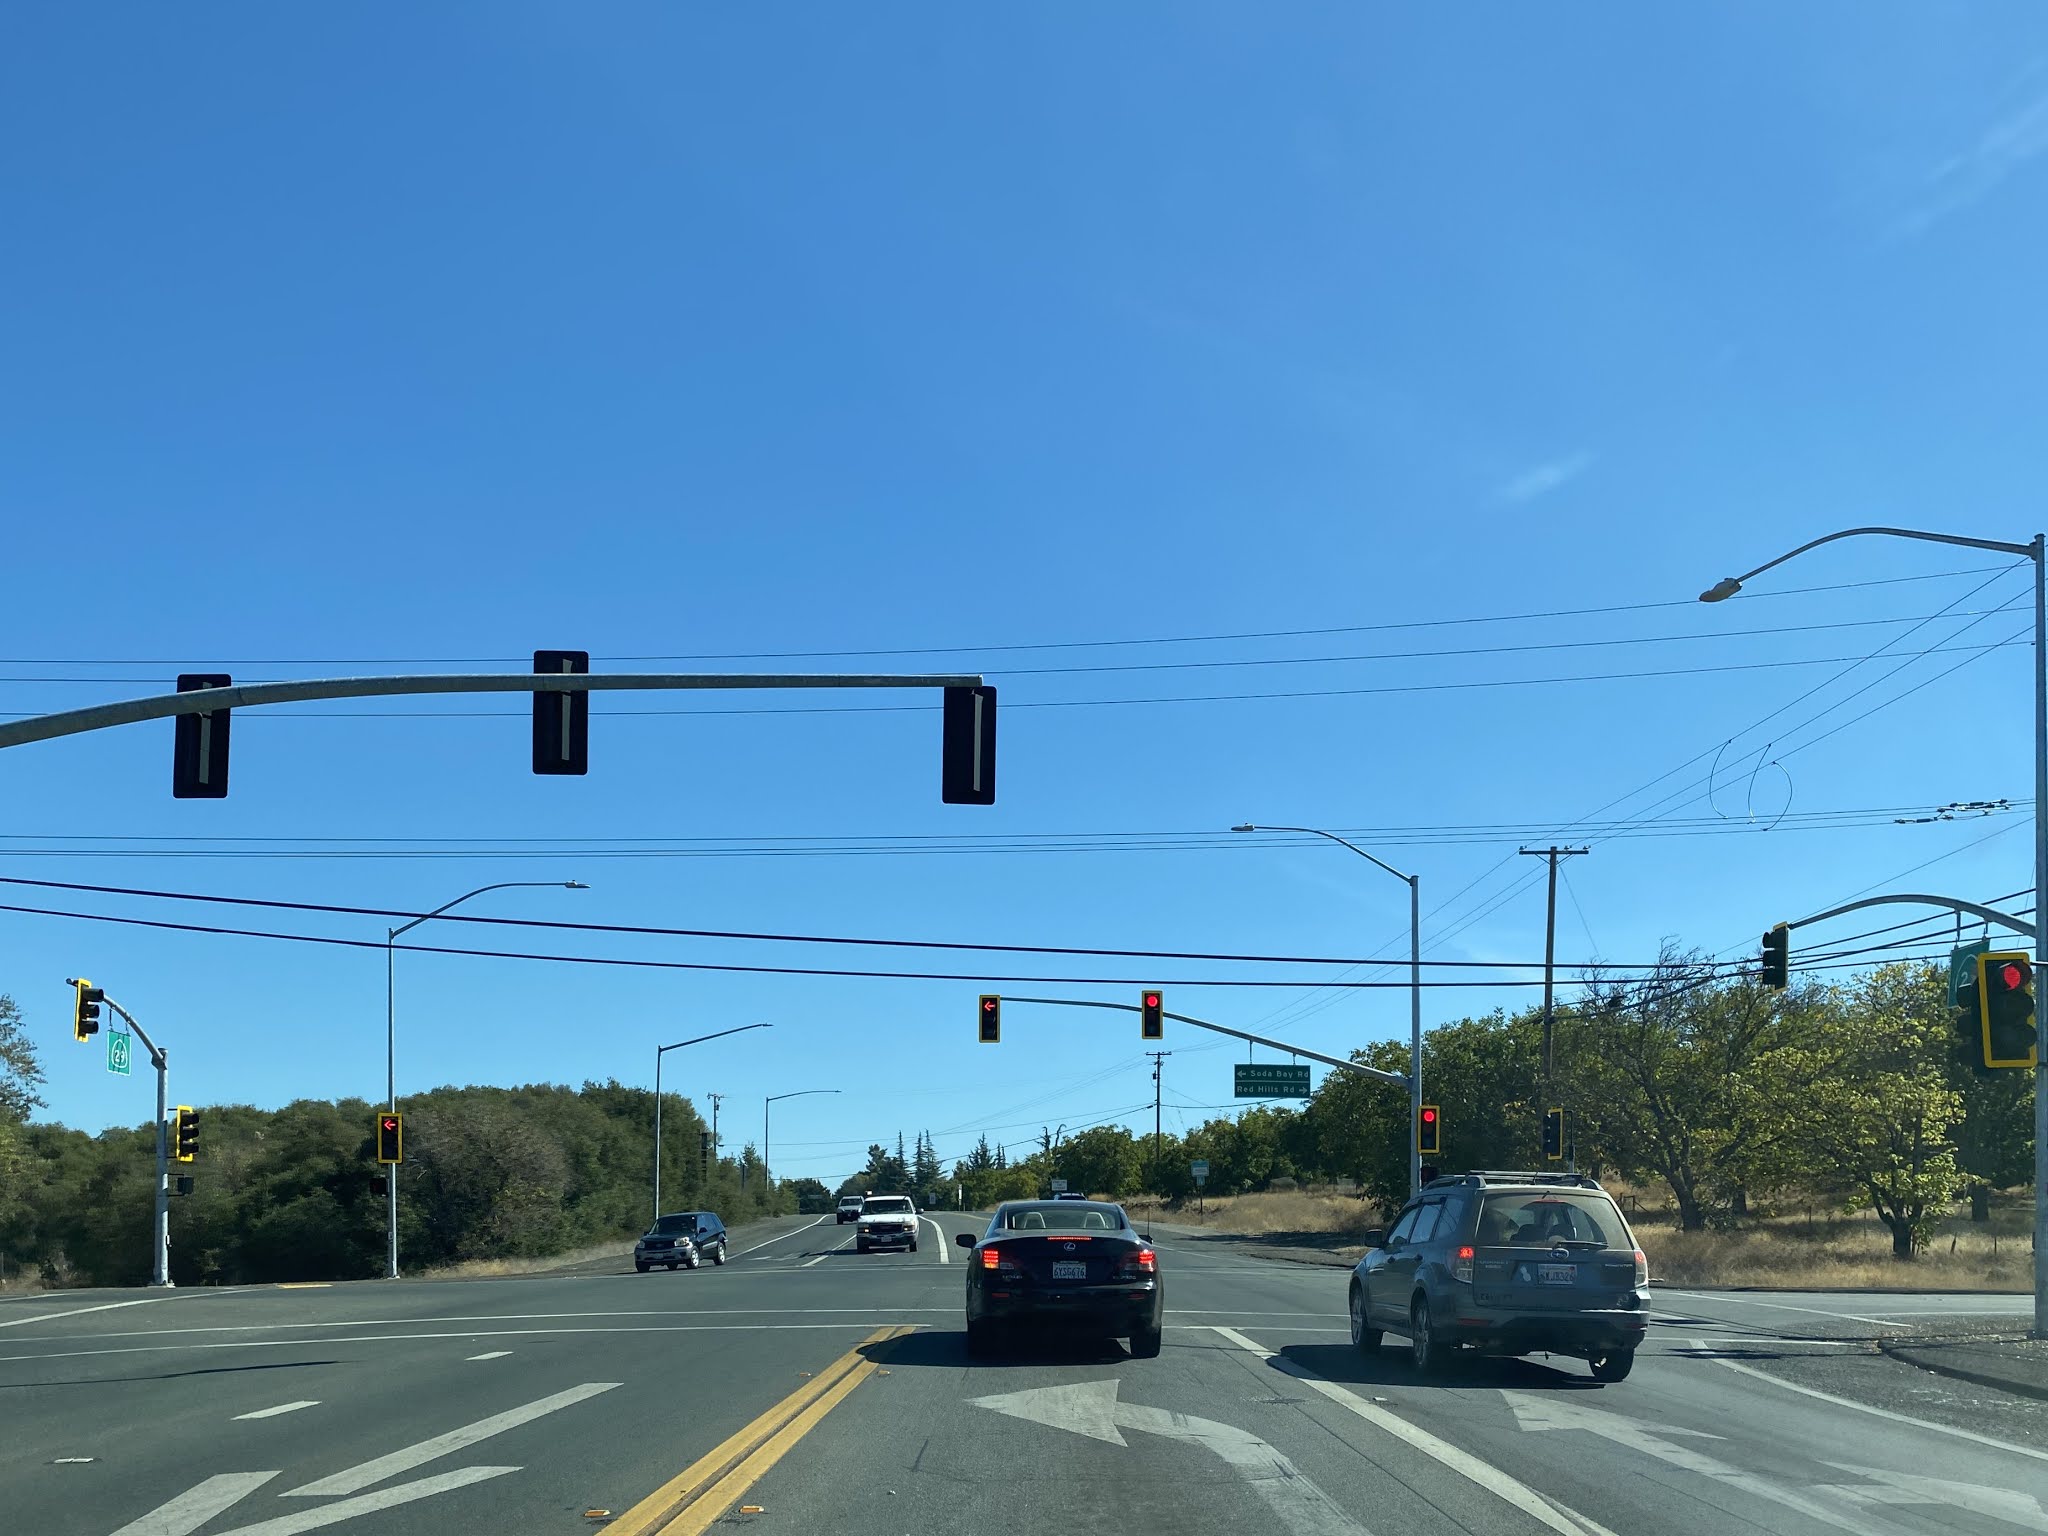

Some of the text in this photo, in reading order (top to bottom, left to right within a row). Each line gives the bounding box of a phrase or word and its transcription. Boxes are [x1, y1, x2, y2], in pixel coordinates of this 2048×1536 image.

[1250, 1069, 1309, 1079] Soda Bay Rd
[1236, 1085, 1254, 1093] Red
[1257, 1085, 1279, 1093] Hills
